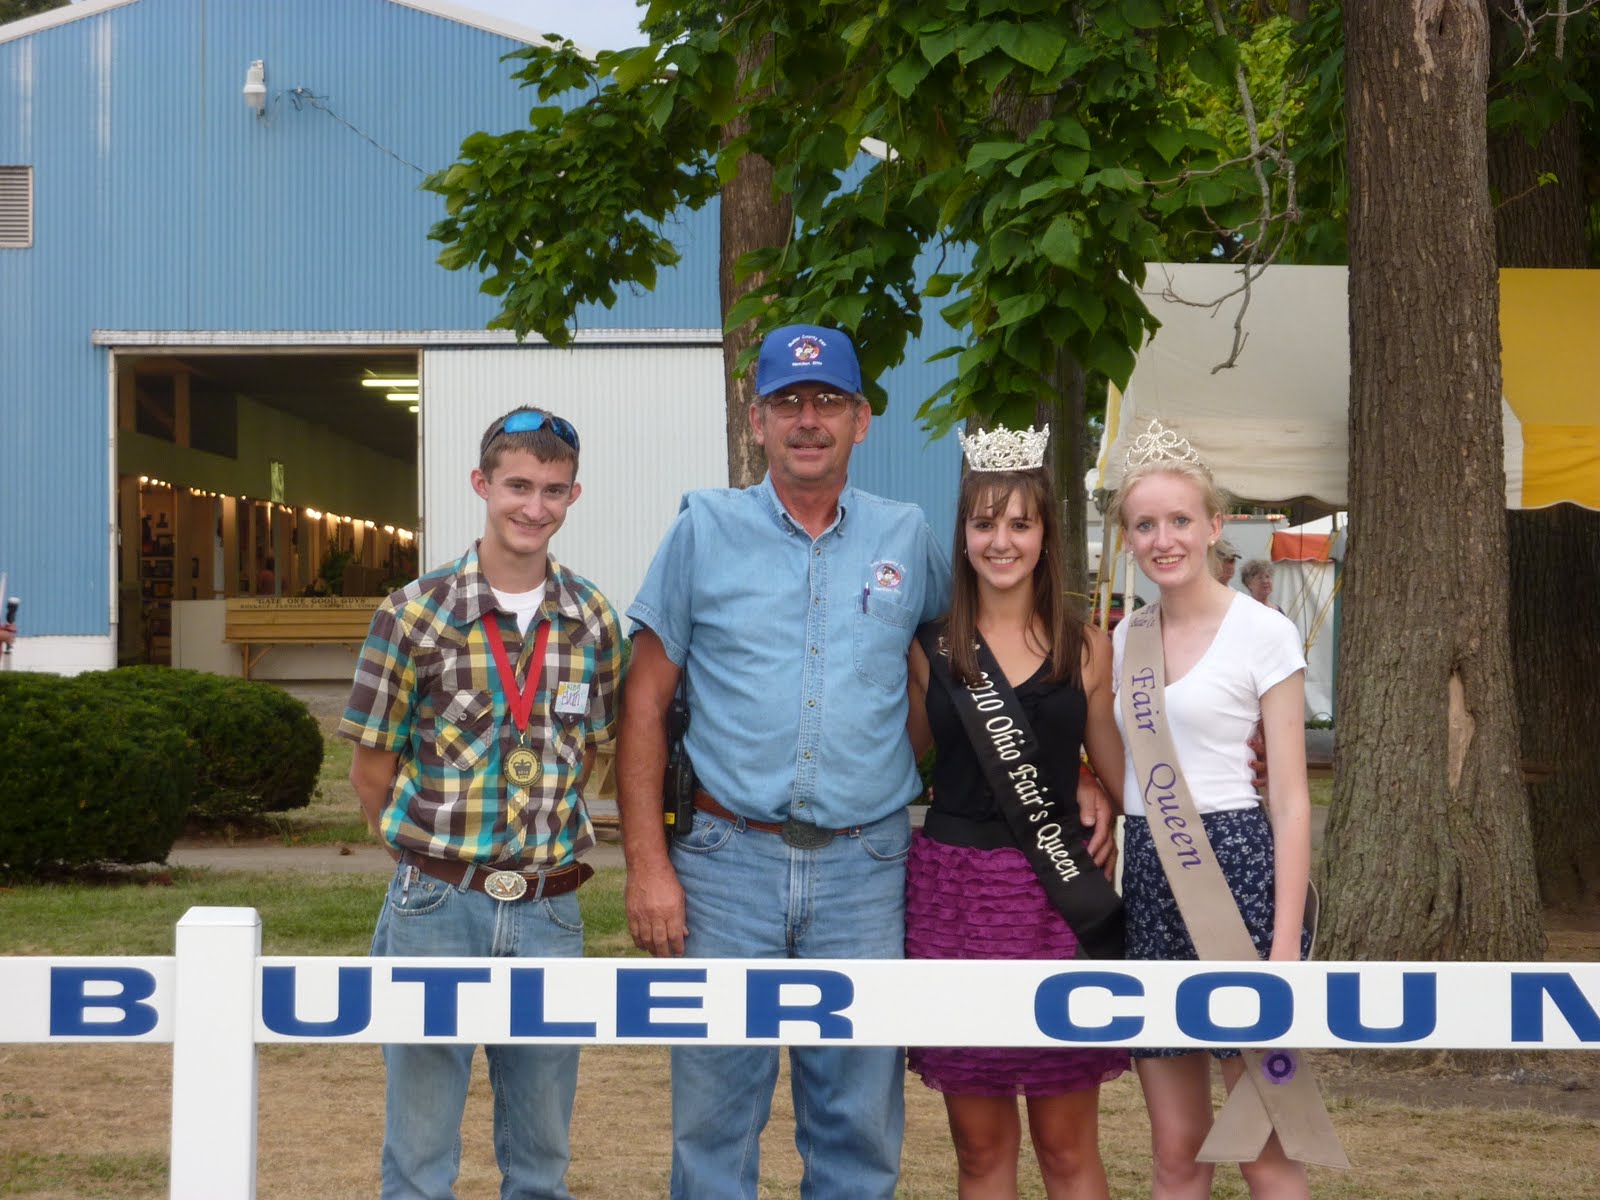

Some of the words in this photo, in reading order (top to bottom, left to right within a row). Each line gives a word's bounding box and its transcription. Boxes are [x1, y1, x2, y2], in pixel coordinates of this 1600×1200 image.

[1131, 667, 1160, 734] Fair
[985, 715, 1025, 761] Ohio
[1008, 763, 1055, 822] Fair's
[1036, 823, 1081, 882] Queen
[1144, 762, 1202, 870] Queen
[50, 967, 853, 1039] BUTLER
